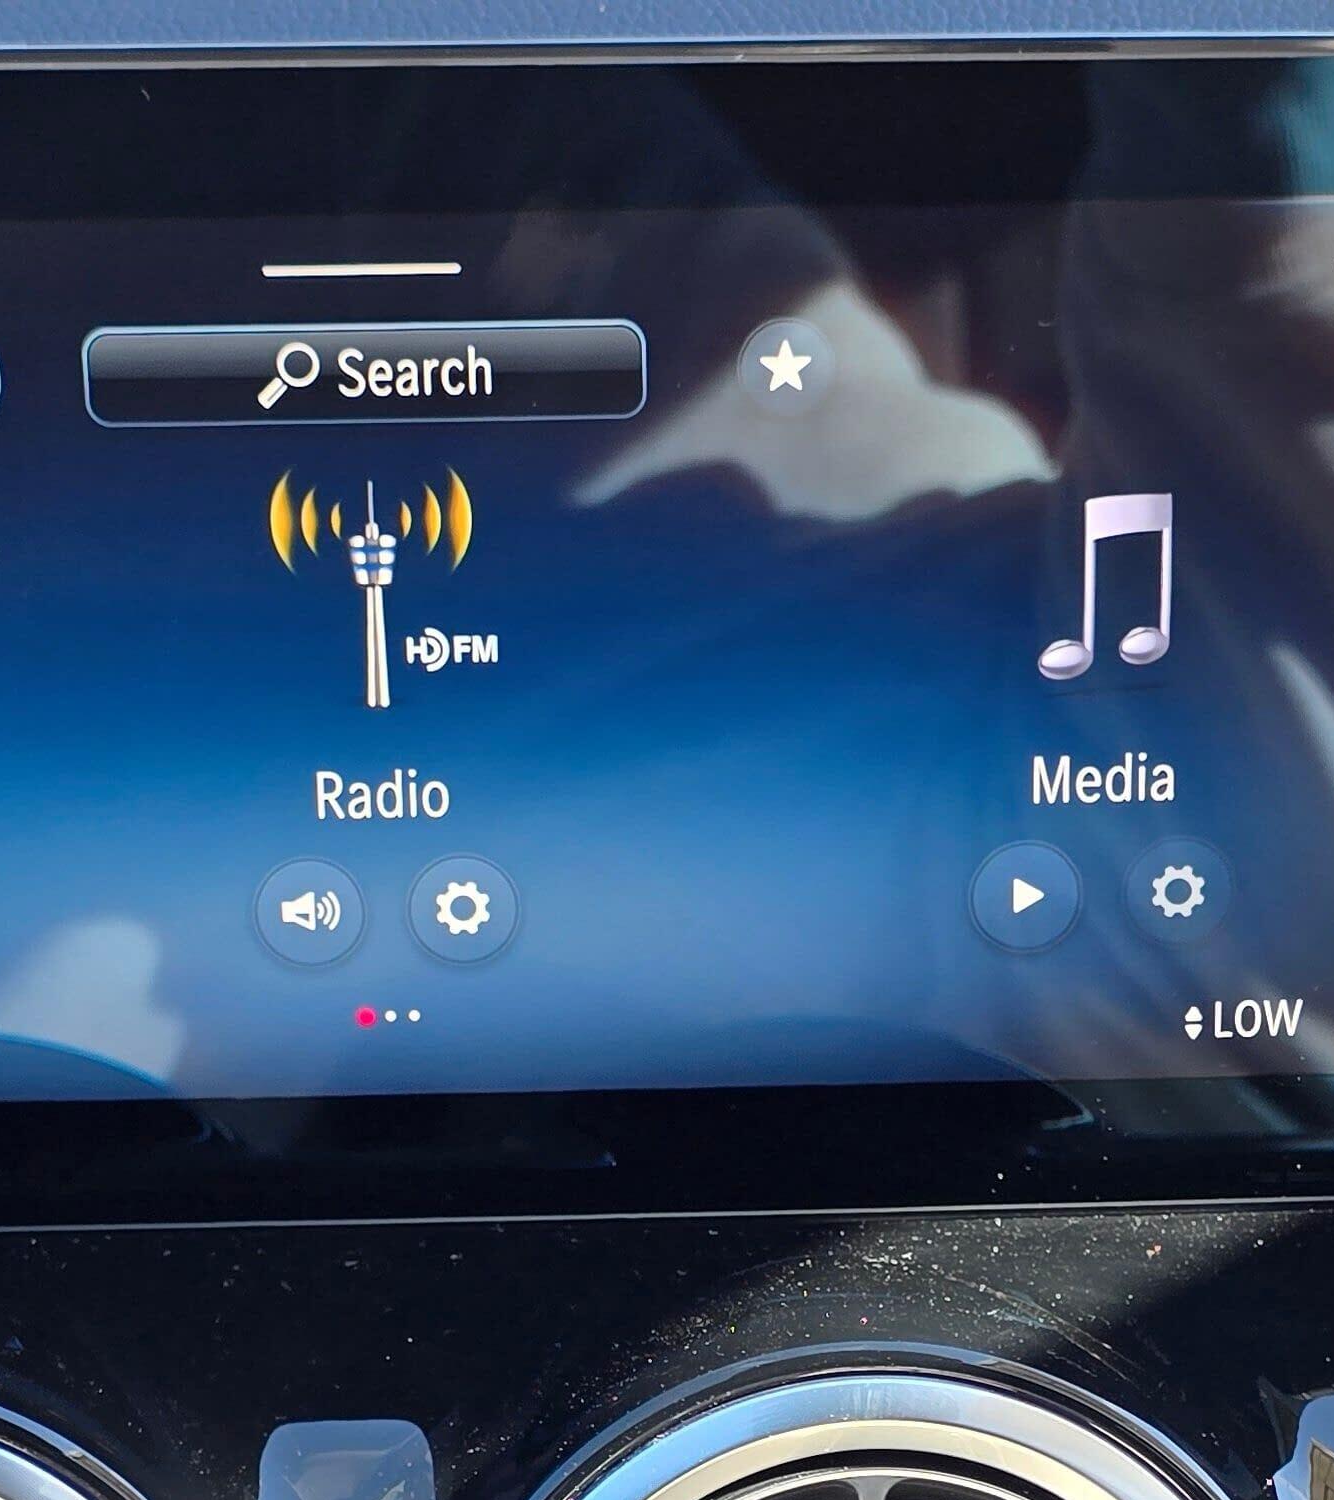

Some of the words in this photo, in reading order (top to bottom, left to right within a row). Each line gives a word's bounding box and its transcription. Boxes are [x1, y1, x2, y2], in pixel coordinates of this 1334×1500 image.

[336, 345, 494, 399] Search
[453, 634, 499, 663] FM
[315, 768, 451, 821] Radio
[1031, 752, 1177, 805] Media
[1213, 998, 1304, 1039] LOW
